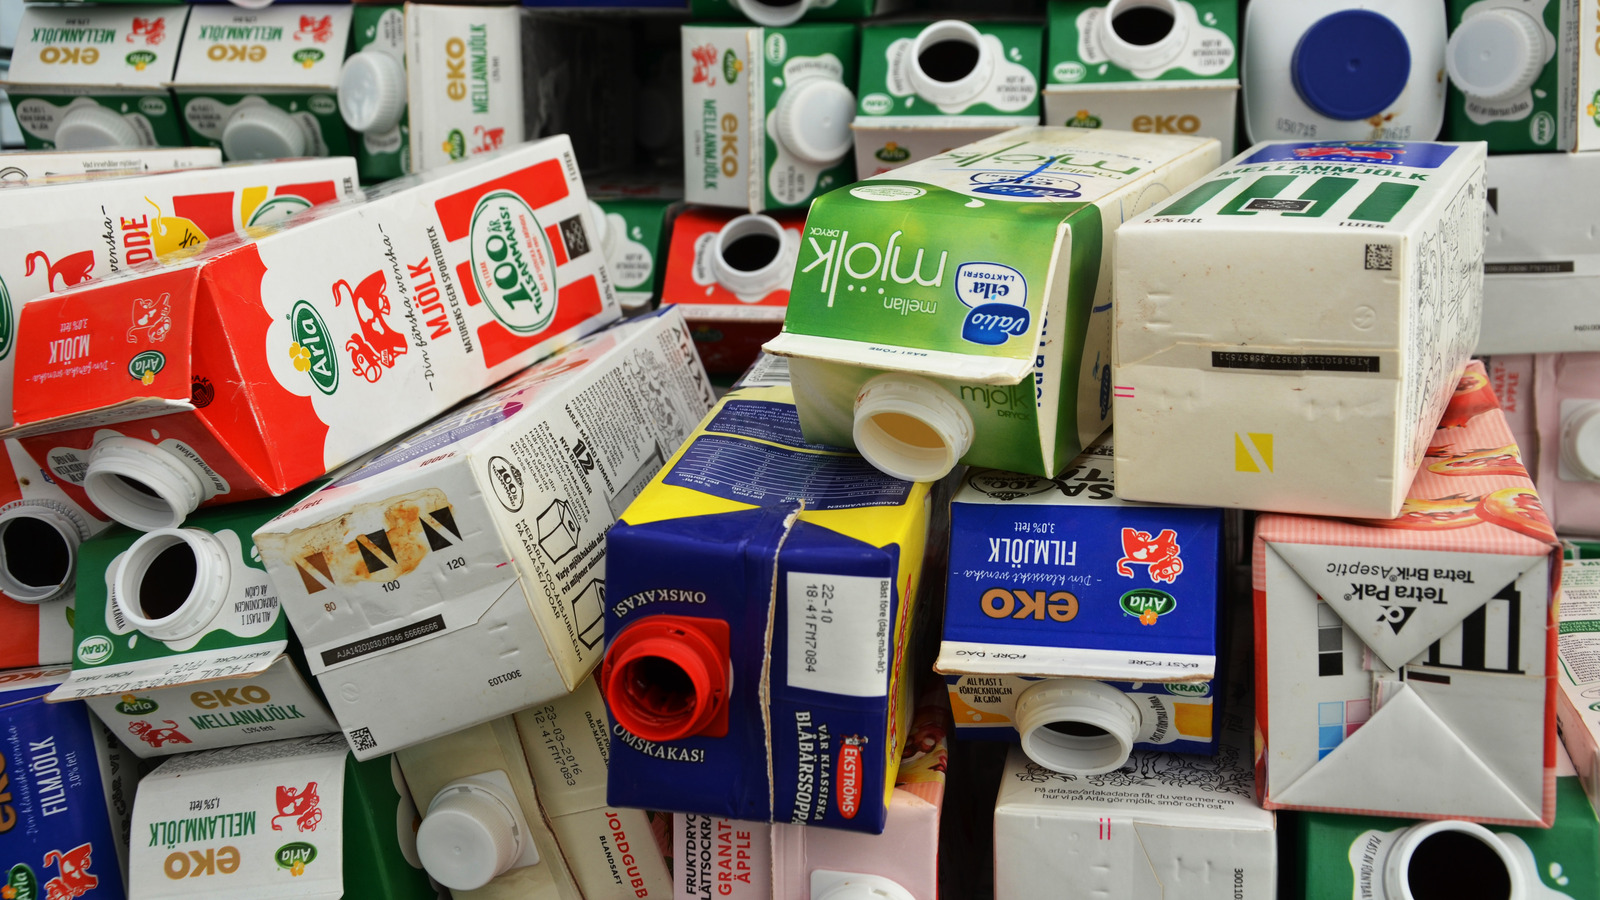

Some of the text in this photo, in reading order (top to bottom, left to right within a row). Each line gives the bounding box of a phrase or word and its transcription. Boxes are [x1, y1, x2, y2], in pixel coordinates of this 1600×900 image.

[31, 27, 116, 44] MELLANMJÖLK
[199, 24, 283, 41] MELLANMJÖLK
[40, 46, 100, 65] eko
[207, 44, 267, 62] eko
[445, 37, 467, 101] eko
[469, 23, 489, 115] MELLANMJÖLK
[1132, 114, 1202, 134] eko
[703, 98, 718, 191] MELLANMJÖLK
[721, 113, 739, 178] eko
[1216, 163, 1430, 182] MELLANMJÖLK
[810, 226, 840, 238] DRYCK
[102, 217, 118, 271] venska
[499, 206, 542, 313] TILLSAMMANS!
[802, 230, 948, 308] mjölk
[485, 234, 532, 309] 100
[963, 270, 1016, 282] LAKTOSFRI
[407, 257, 450, 339] MJÖLK
[426, 226, 473, 353] NATURENS EGEN SPORTDRYCK
[383, 234, 434, 380] Din färska svenska
[883, 296, 938, 316] mellan
[971, 312, 1026, 334] Valio
[48, 334, 90, 366] MJÖLK
[309, 316, 332, 377] Arla
[134, 357, 160, 372] Arla
[1506, 372, 1520, 413] ÄPPLE
[996, 408, 1030, 422] DRYCK
[564, 403, 614, 494] VARJE MÅNAD KOMMER
[572, 438, 594, 474] 12
[559, 436, 592, 495] NYA BAKSIDOR
[826, 500, 900, 509] NÄRINGSVÄRDEN
[515, 522, 524, 536] PÅ
[1014, 522, 1056, 534] 3,0% fett
[446, 557, 466, 571] 120
[988, 538, 1077, 568] FILMJÖLK
[555, 566, 569, 581] Varje
[561, 565, 588, 594] två miljoner
[963, 570, 1092, 587] Din klassiskt svenska
[1326, 562, 1393, 580] Aseptic
[1434, 570, 1474, 584] Tetra
[244, 584, 268, 596] ÄR GRÖN
[382, 580, 401, 594] 100
[520, 518, 593, 662] MER ARLA 100-ÅRSJUBILEUM
[880, 580, 890, 598] Bäst
[1395, 587, 1448, 604] Tetra
[234, 596, 278, 614] FÖRPACKNINGEN
[324, 601, 338, 613] 80
[612, 588, 706, 618] OMSKAKAS!
[820, 583, 834, 624] 22-10
[878, 598, 889, 618] före
[980, 587, 1080, 622] eko
[1129, 596, 1168, 612] Arla
[80, 642, 109, 656] KRAV
[956, 650, 1027, 660] FÖRP. DAG
[1128, 658, 1163, 667] FÖRE
[487, 668, 523, 688] 3001103
[966, 677, 977, 687] ALL
[978, 677, 998, 688] PLAST
[190, 685, 271, 710] eko
[958, 685, 1013, 696] FÖRPACKNINGEN
[973, 694, 1002, 704] ÄR GRÖN
[122, 700, 152, 714] Arla
[189, 704, 305, 730] MELLANMJÖLK
[241, 725, 258, 735] 1,5%
[543, 704, 582, 776] 23-03-2016
[612, 724, 705, 763] OMSKAKAS!
[28, 736, 68, 818] FILMJÖLK
[66, 750, 82, 789] 3,0% fett
[792, 710, 818, 826] BLÅBÄRSSOPPA
[814, 724, 830, 820] VÅR KLASSISKA
[842, 748, 858, 814] EKSTRÖMS
[188, 797, 220, 812] 1,5% fett
[1048, 788, 1140, 799] arla.se/arlakadabra
[148, 811, 257, 848] MELLANMJÖLK
[280, 848, 312, 861] Arla
[686, 812, 697, 896] FRUKTDRYC
[1364, 834, 1382, 855] PLAST
[164, 846, 241, 880] eko
[598, 836, 623, 886] BLANDSAFT
[605, 812, 649, 900] JORDGUBB
[718, 818, 732, 896] GRANAT-
[734, 831, 750, 884] ÄPPLE
[12, 871, 29, 900] Arla
